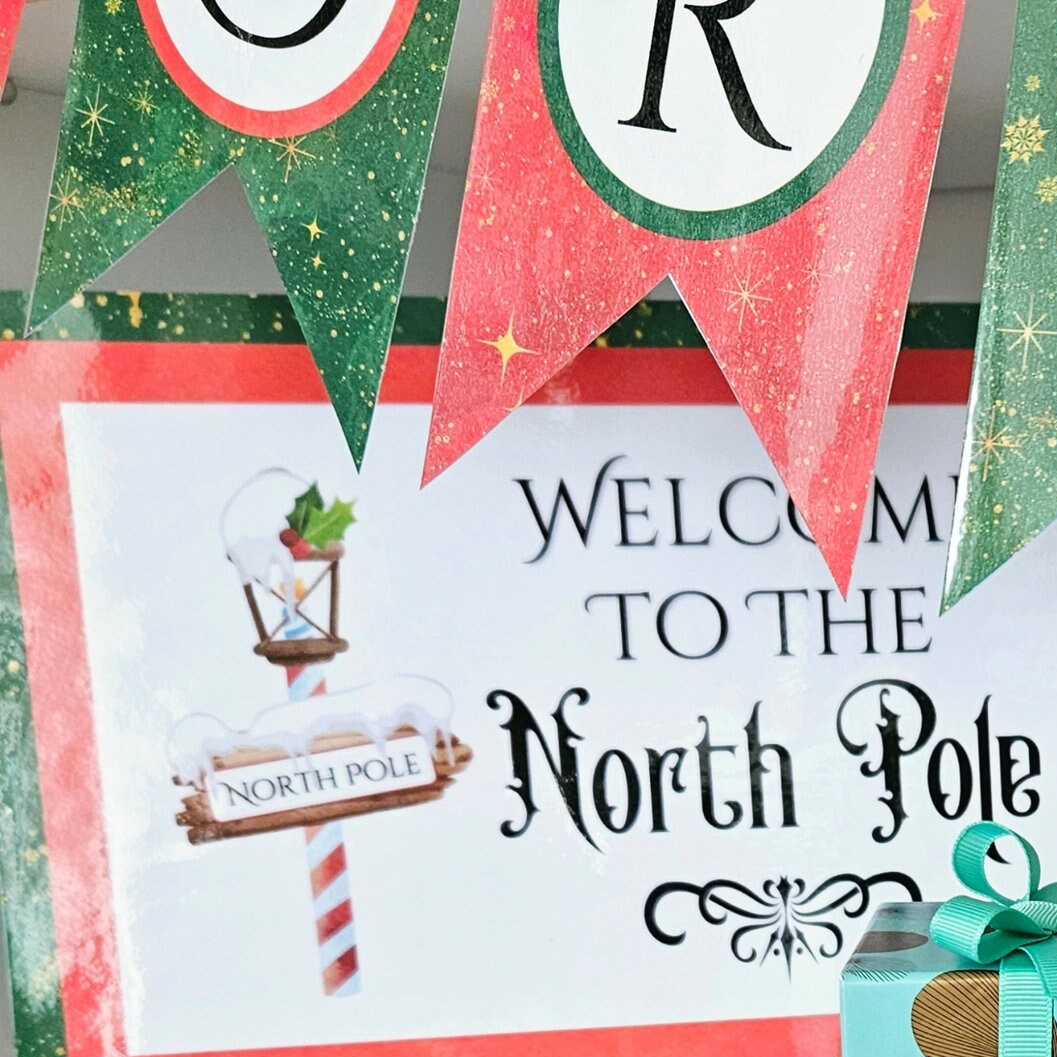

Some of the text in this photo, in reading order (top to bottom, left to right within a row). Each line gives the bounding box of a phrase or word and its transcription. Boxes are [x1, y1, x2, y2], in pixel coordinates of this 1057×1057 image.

[512, 453, 958, 565] WELCM
[584, 586, 933, 661] TO THE
[219, 752, 421, 806] NORTH POLE
[486, 677, 1042, 865] North Pole
